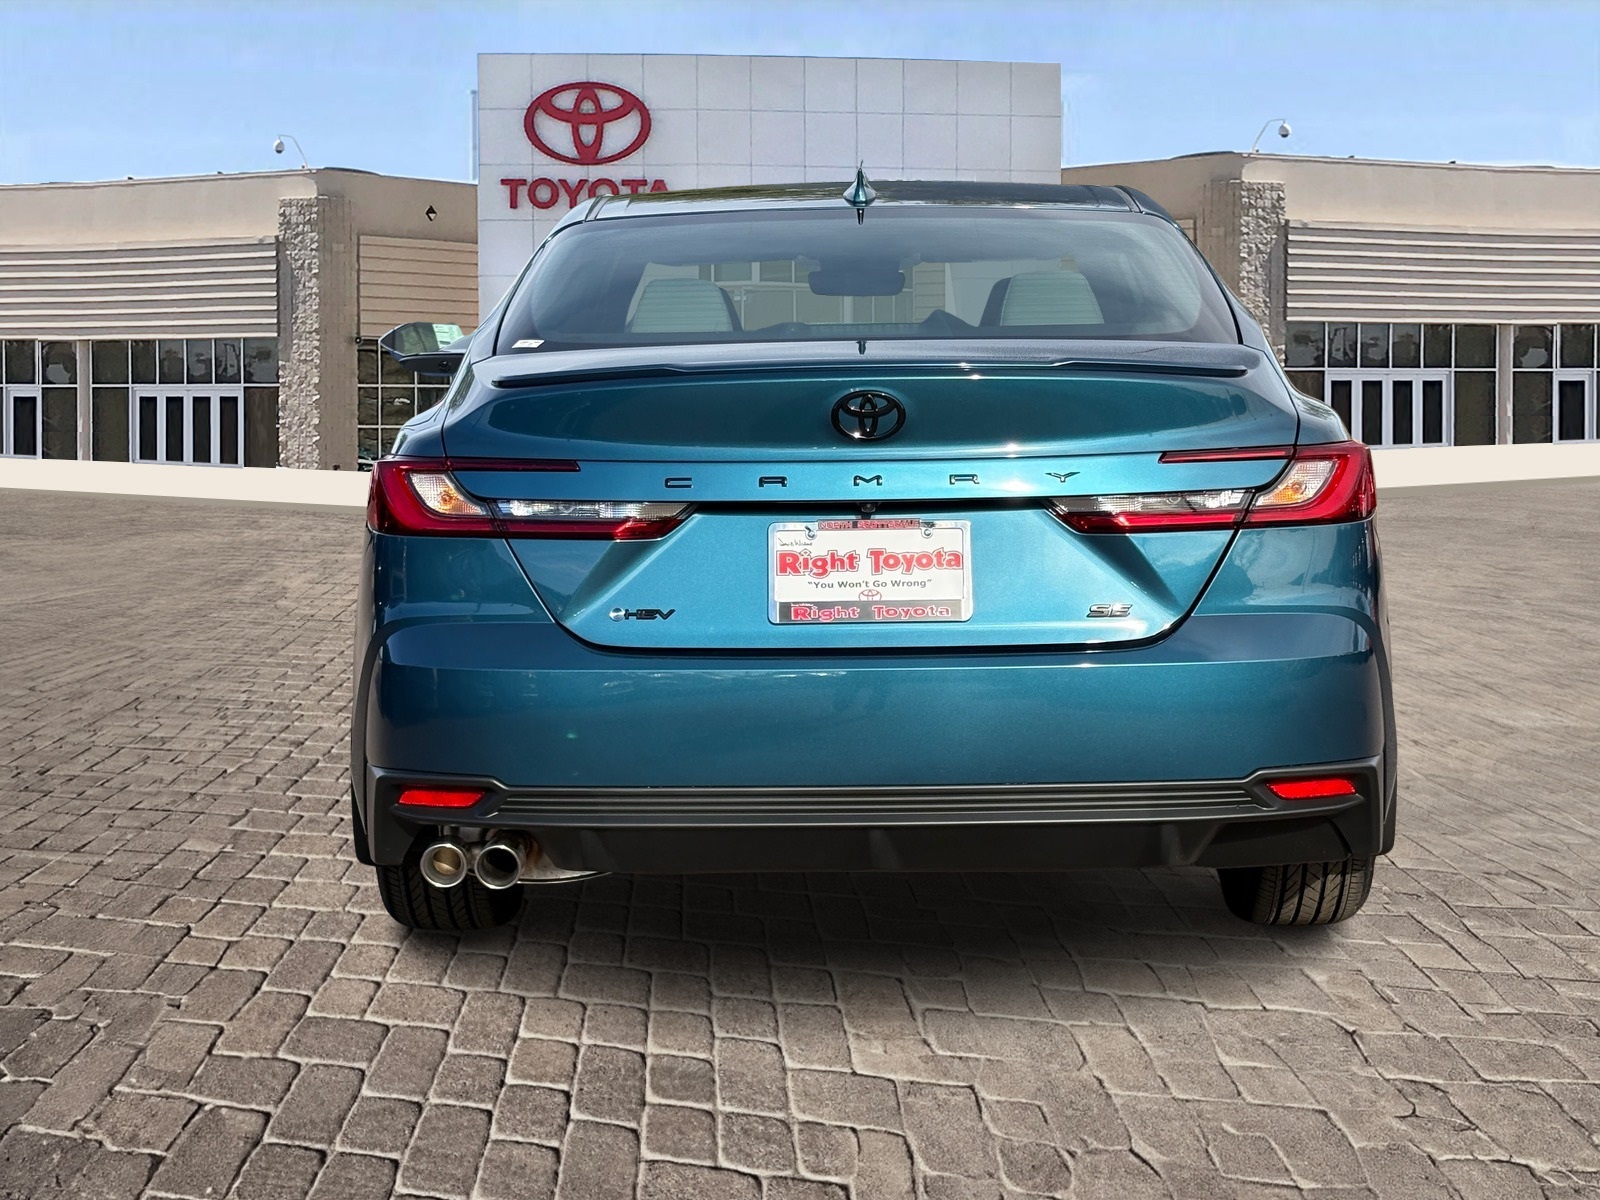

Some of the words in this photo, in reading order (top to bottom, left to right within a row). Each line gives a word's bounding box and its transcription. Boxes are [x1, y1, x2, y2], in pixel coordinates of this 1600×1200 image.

[664, 471, 1081, 488] CAMRY
[776, 550, 859, 578] Right
[867, 548, 963, 575] Toyota
[873, 580, 888, 588] Go
[791, 604, 860, 622] Right
[872, 605, 950, 619] Toyota
[1086, 604, 1133, 618] SE
